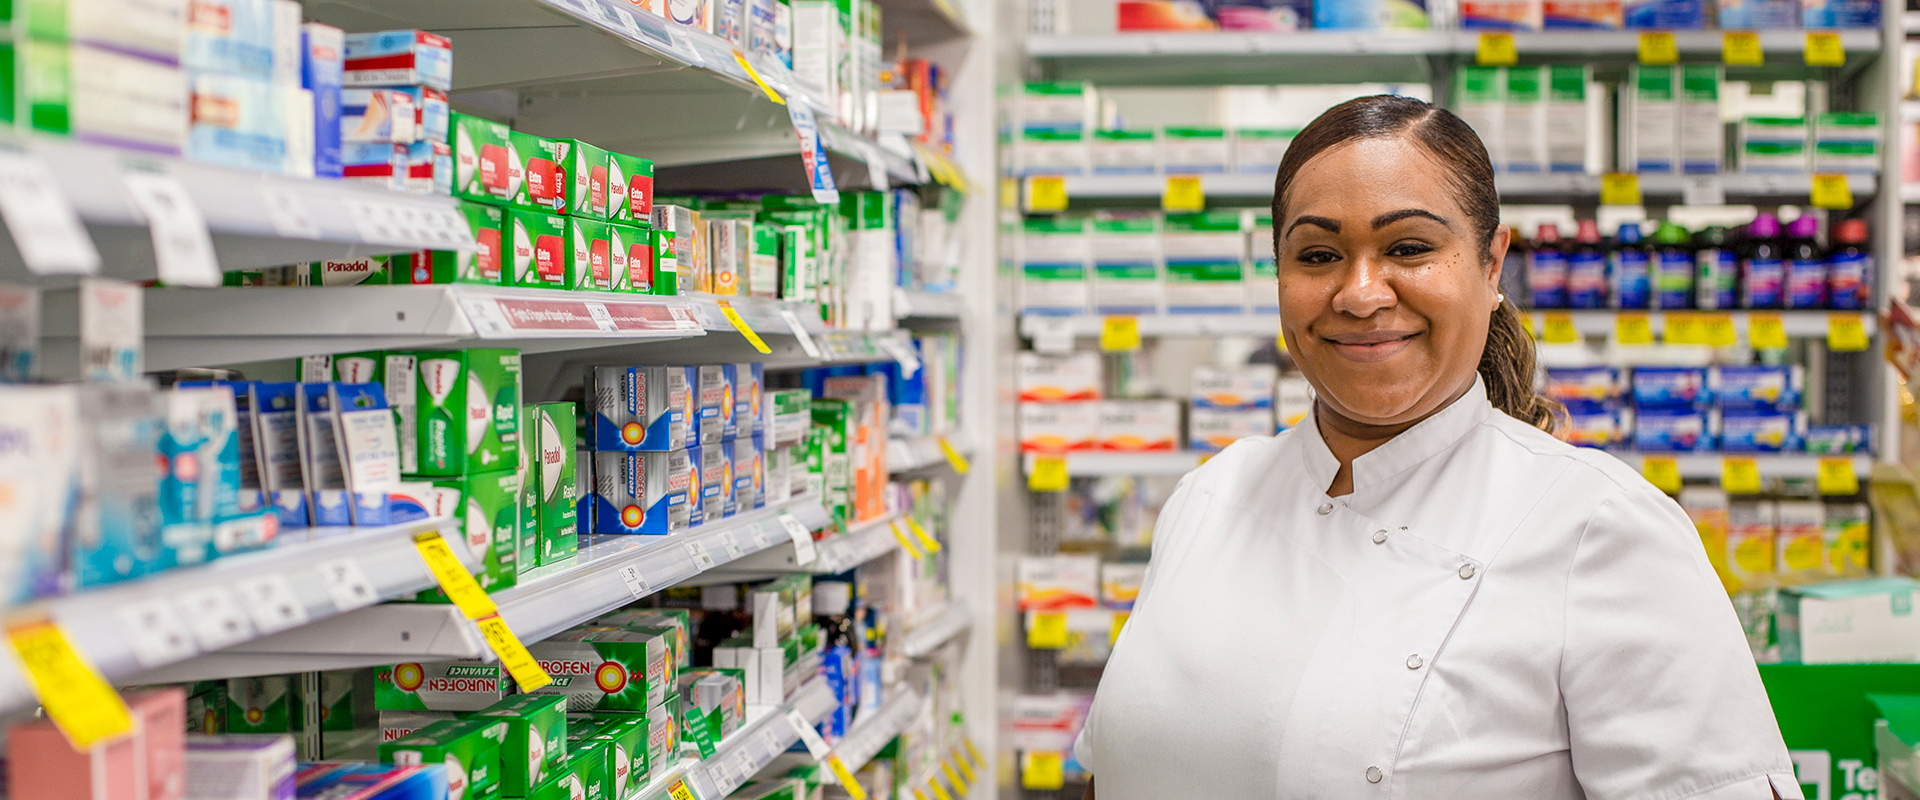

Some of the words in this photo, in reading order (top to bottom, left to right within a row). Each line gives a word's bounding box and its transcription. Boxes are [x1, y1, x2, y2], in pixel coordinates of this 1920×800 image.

[631, 187, 644, 200] Extra
[537, 248, 551, 261] Extra
[592, 252, 603, 265] Extra
[326, 260, 369, 272] Panadol
[630, 256, 641, 269] Extra
[636, 373, 646, 416] NUROFEN
[543, 445, 561, 466] Panadol
[636, 456, 645, 499] NUROFEN
[449, 667, 496, 675] ZAVANCE
[538, 661, 592, 675] ROFEN
[428, 678, 497, 693] NUROFEN
[1837, 759, 1879, 791] Te
